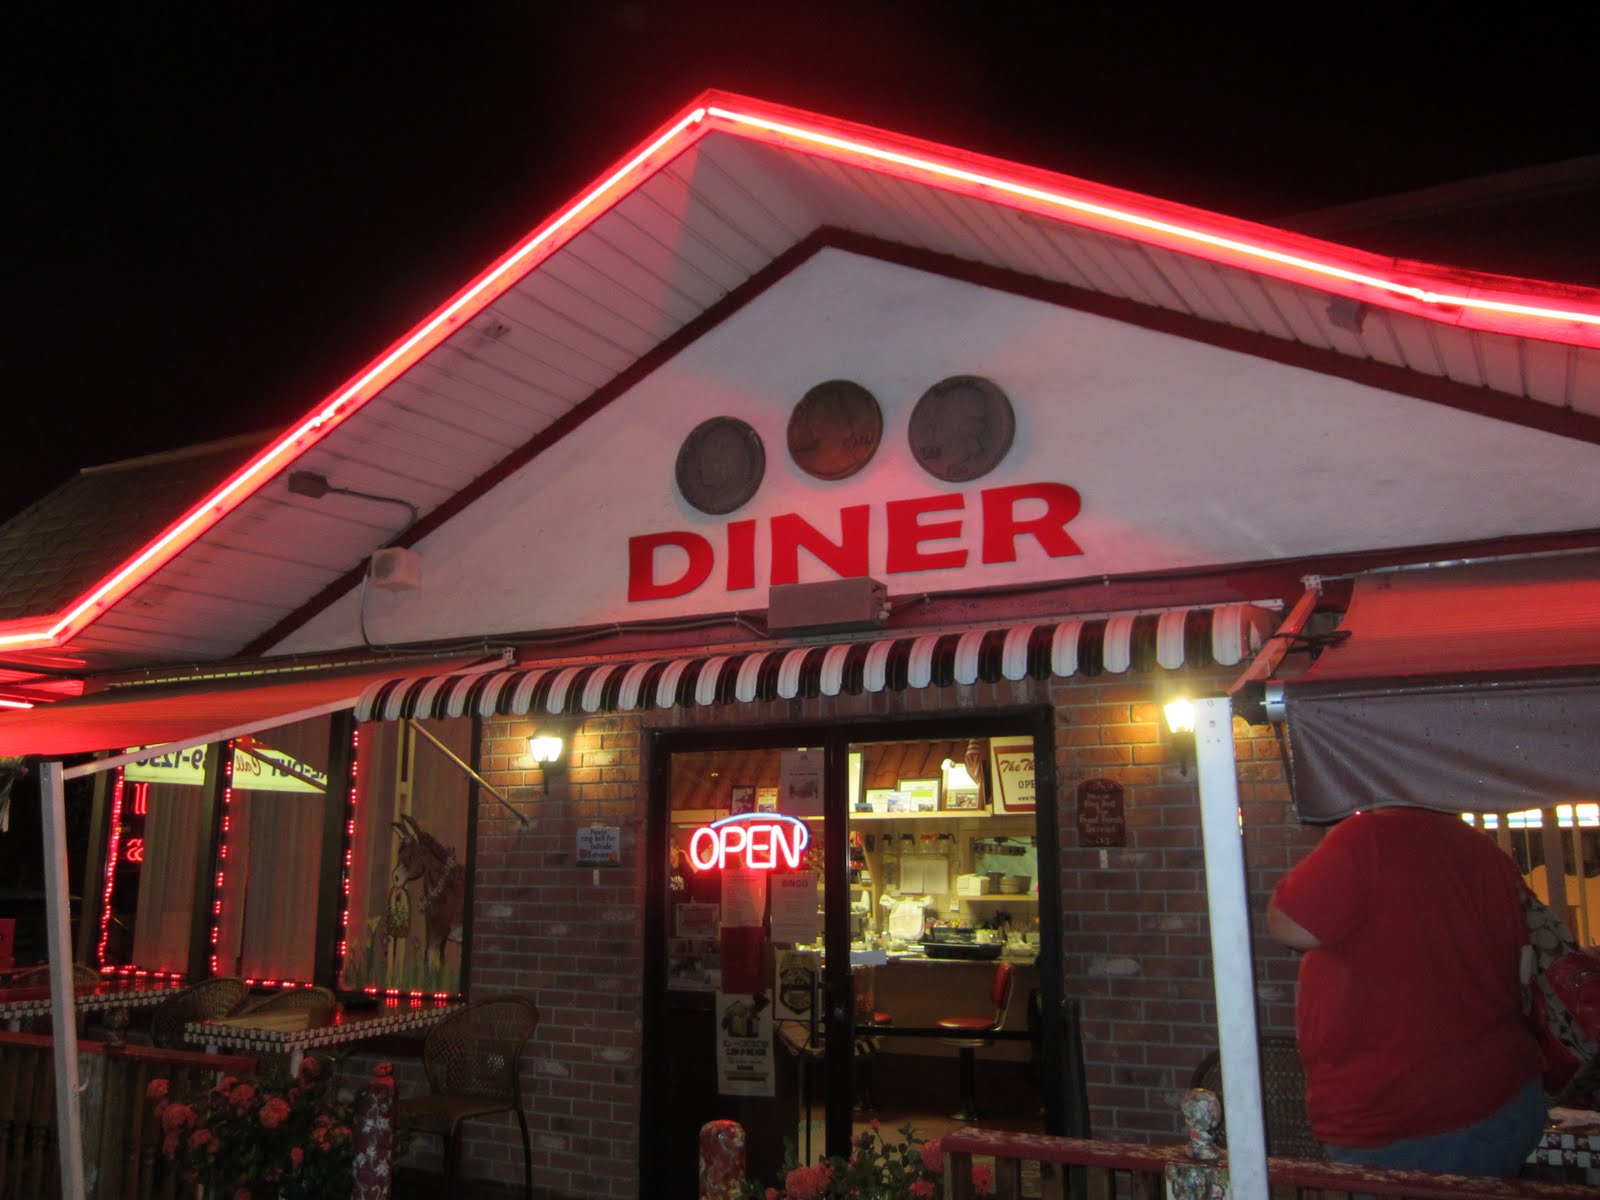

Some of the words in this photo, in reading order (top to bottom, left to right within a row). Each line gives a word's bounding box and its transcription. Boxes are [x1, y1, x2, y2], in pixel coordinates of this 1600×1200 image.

[627, 482, 1085, 602] DINER
[1000, 760, 1020, 772] The
[690, 825, 801, 870] OPEN
[781, 879, 808, 888] BINGO
